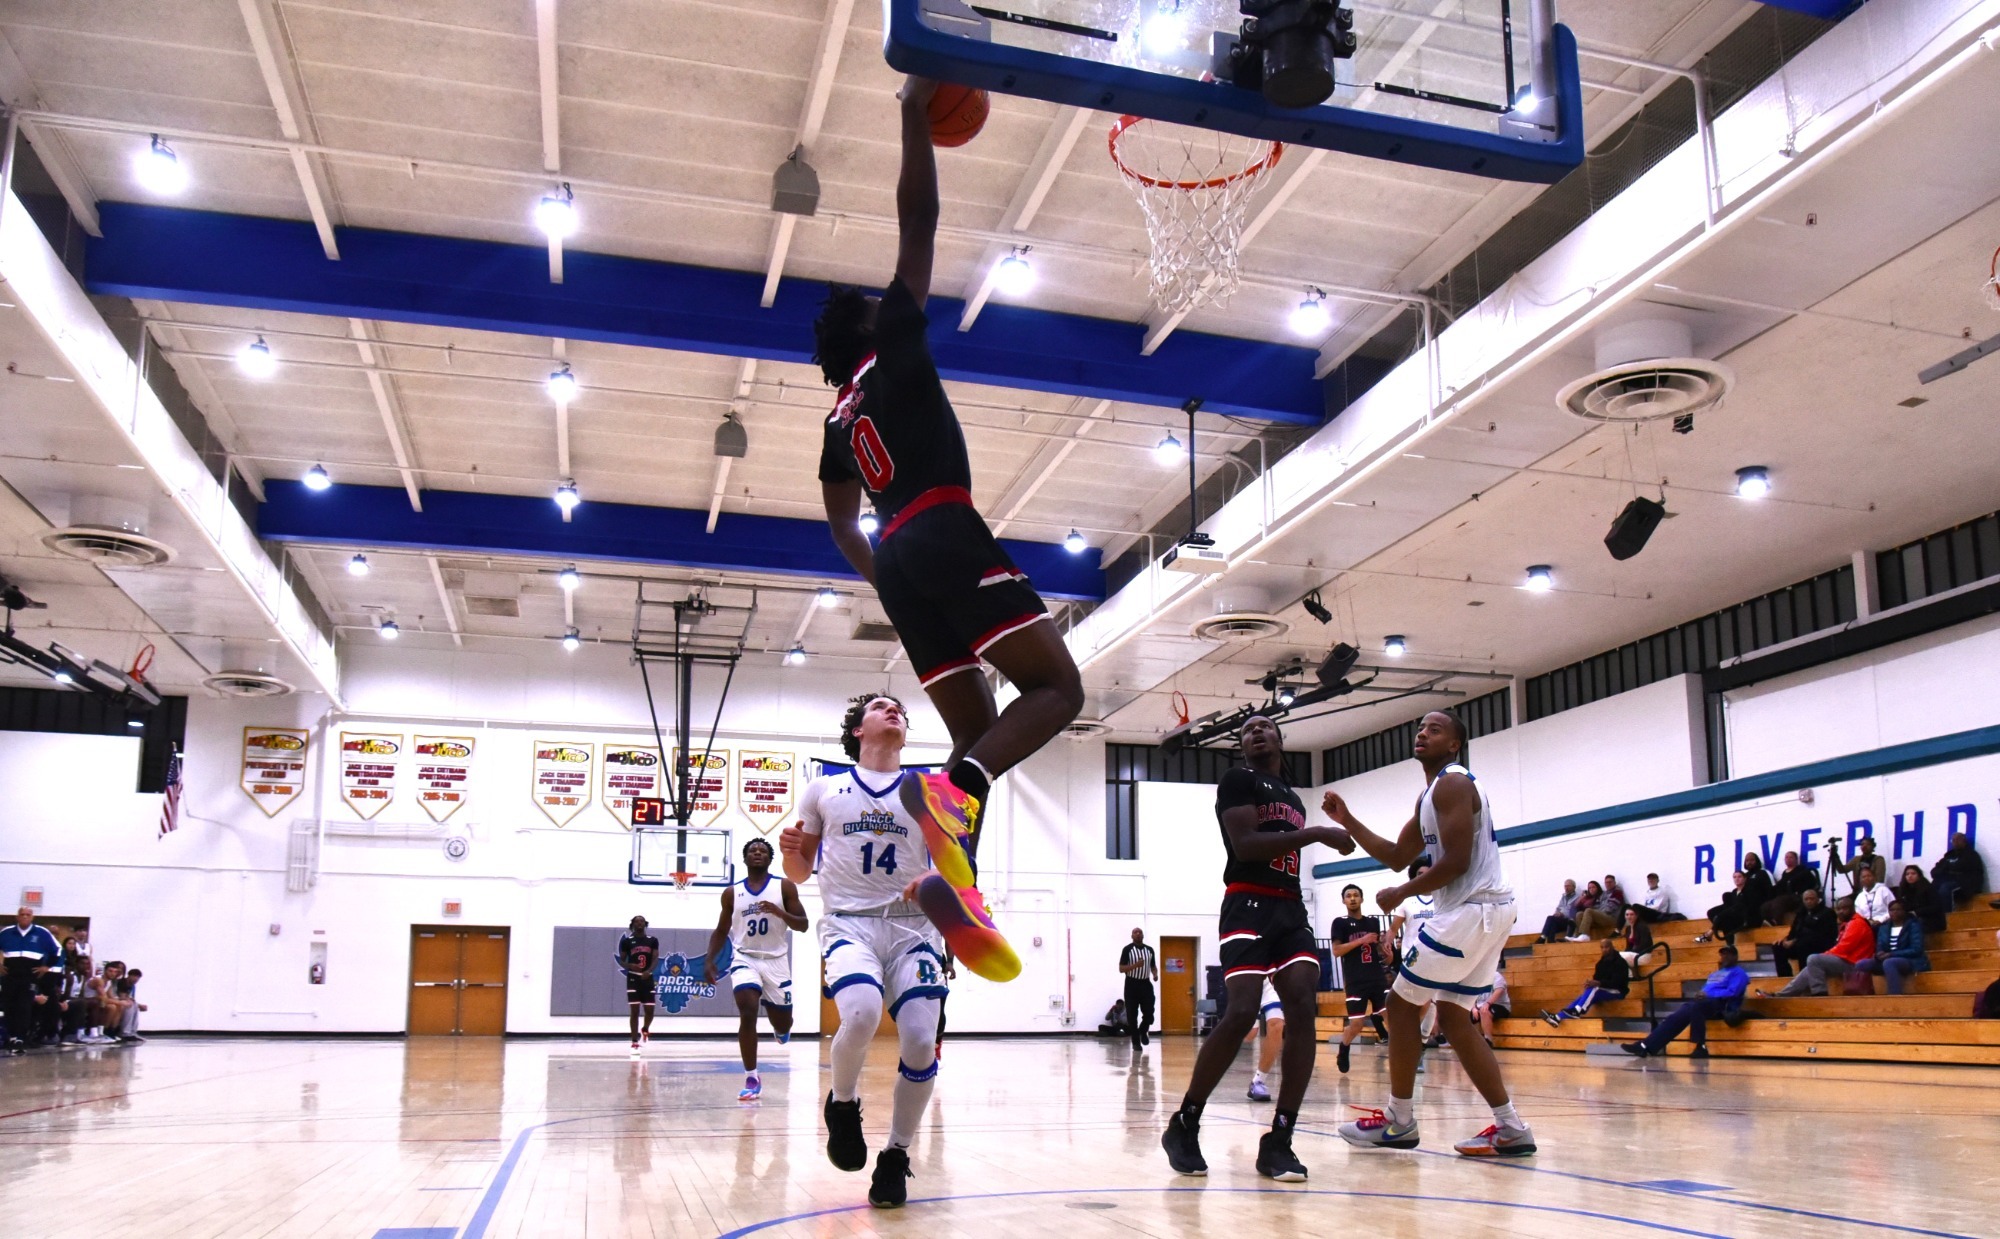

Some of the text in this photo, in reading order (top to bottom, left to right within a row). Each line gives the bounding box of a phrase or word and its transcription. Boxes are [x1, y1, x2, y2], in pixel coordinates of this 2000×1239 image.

[850, 415, 895, 493] 0
[635, 801, 661, 821] 27
[861, 842, 897, 875] 14
[747, 918, 768, 936] 30
[638, 955, 646, 969] 3
[1361, 944, 1372, 964] 2
[658, 976, 694, 986] AACC
[654, 985, 715, 998] ERHAWKS
